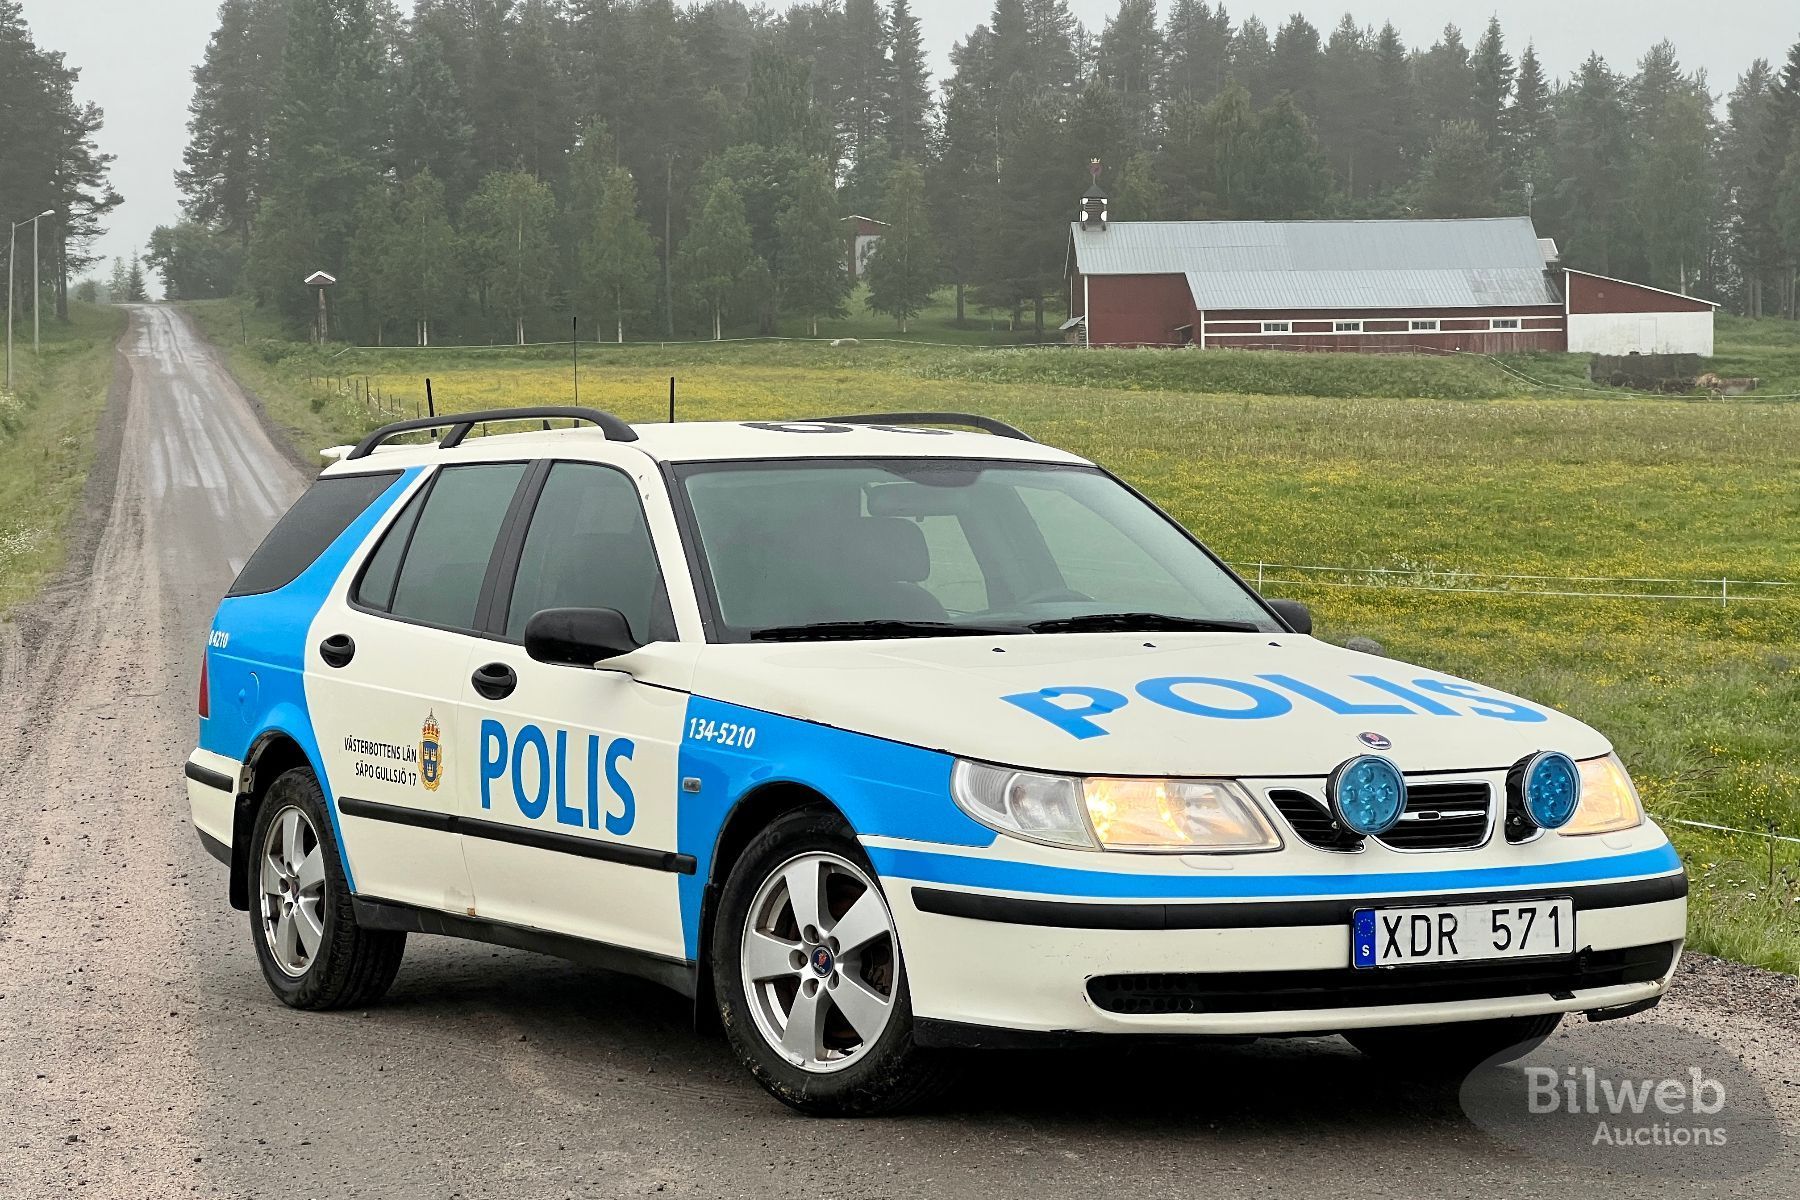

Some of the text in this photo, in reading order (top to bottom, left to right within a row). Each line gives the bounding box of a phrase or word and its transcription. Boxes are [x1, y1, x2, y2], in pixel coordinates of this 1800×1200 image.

[999, 674, 1548, 740] POLIS
[344, 734, 401, 760] VÄSTERBOTTENS
[688, 717, 756, 749] 134-5210
[355, 760, 417, 786] SÄPO GULLSJÖ 17
[480, 719, 636, 836] POLIS
[1382, 905, 1560, 958] XDR 571
[1362, 944, 1370, 957] S
